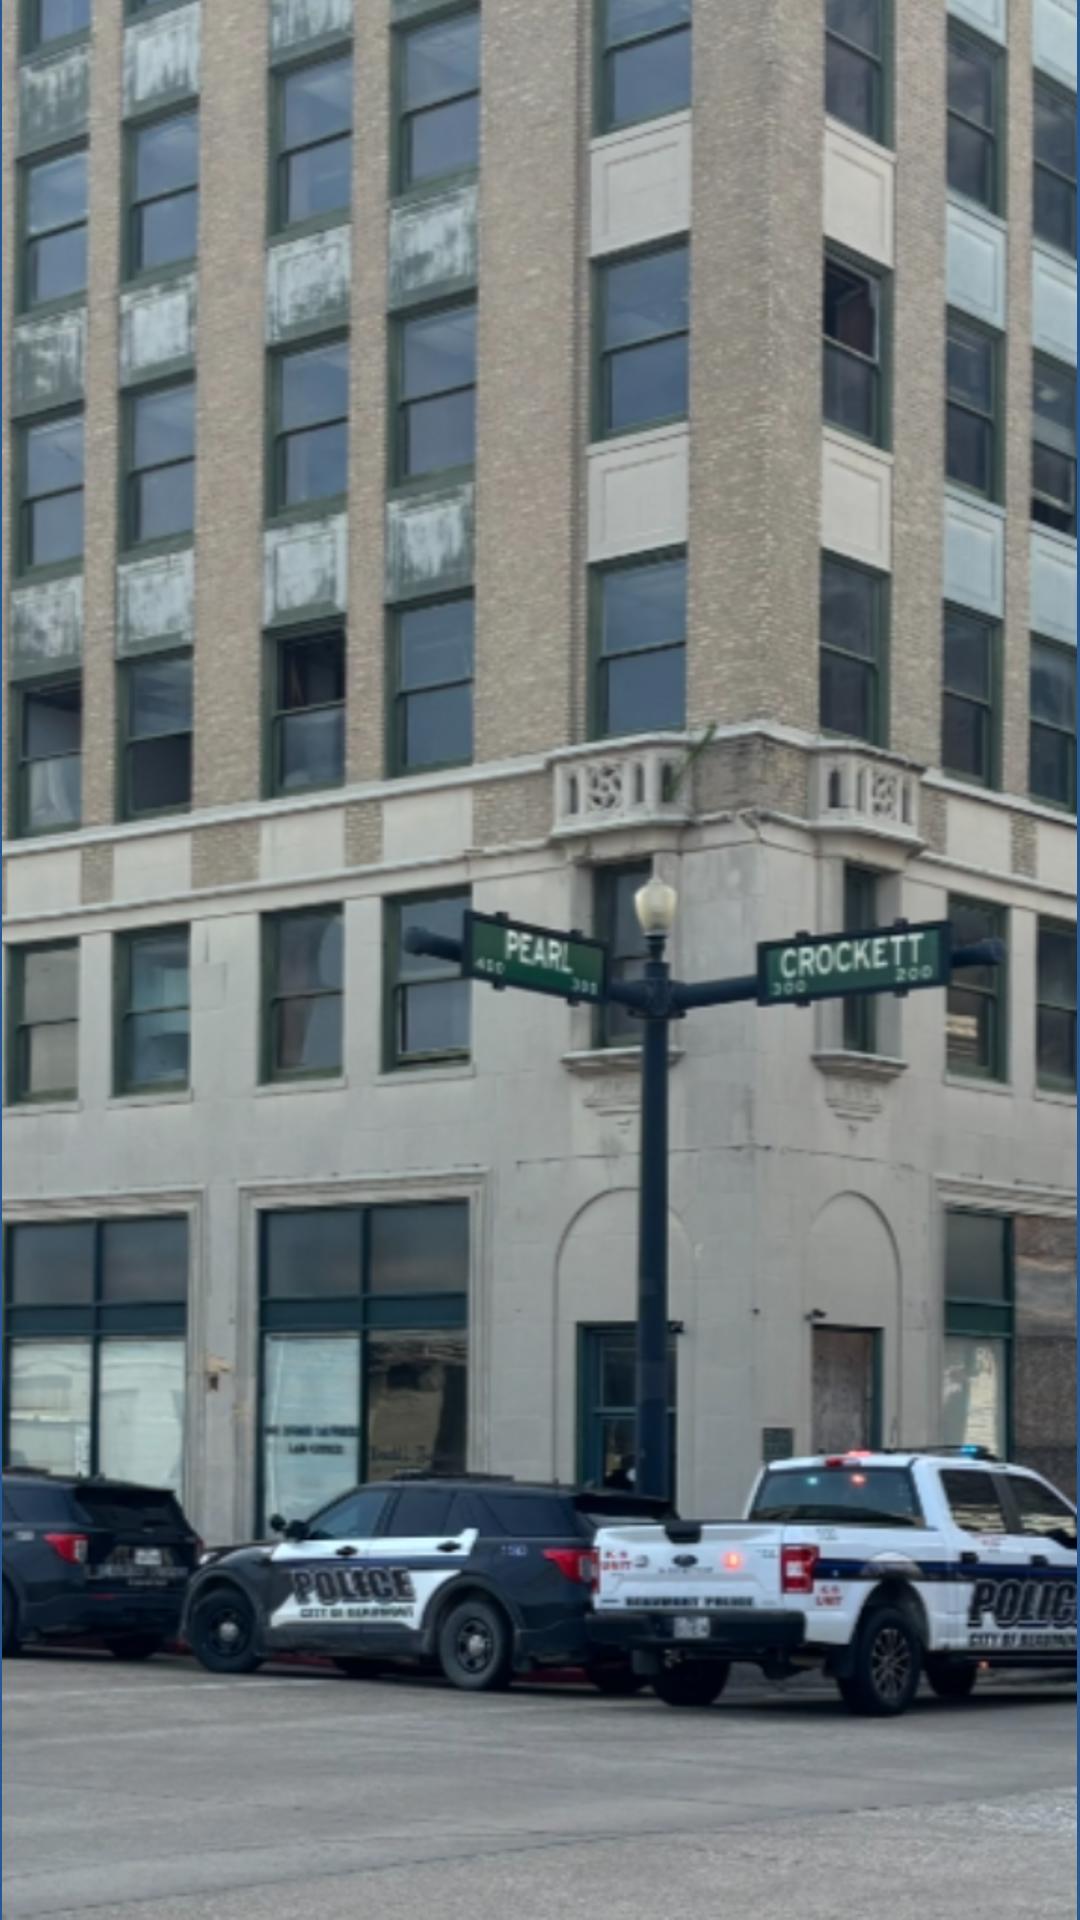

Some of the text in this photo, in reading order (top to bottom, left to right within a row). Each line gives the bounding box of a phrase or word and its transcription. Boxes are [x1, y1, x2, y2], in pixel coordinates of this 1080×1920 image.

[505, 929, 573, 974] PEARL
[780, 932, 924, 979] CROCKETT
[771, 979, 808, 996] 300
[895, 965, 933, 982] 200
[291, 1566, 417, 1605] POLICE
[968, 1633, 998, 1648] CITY
